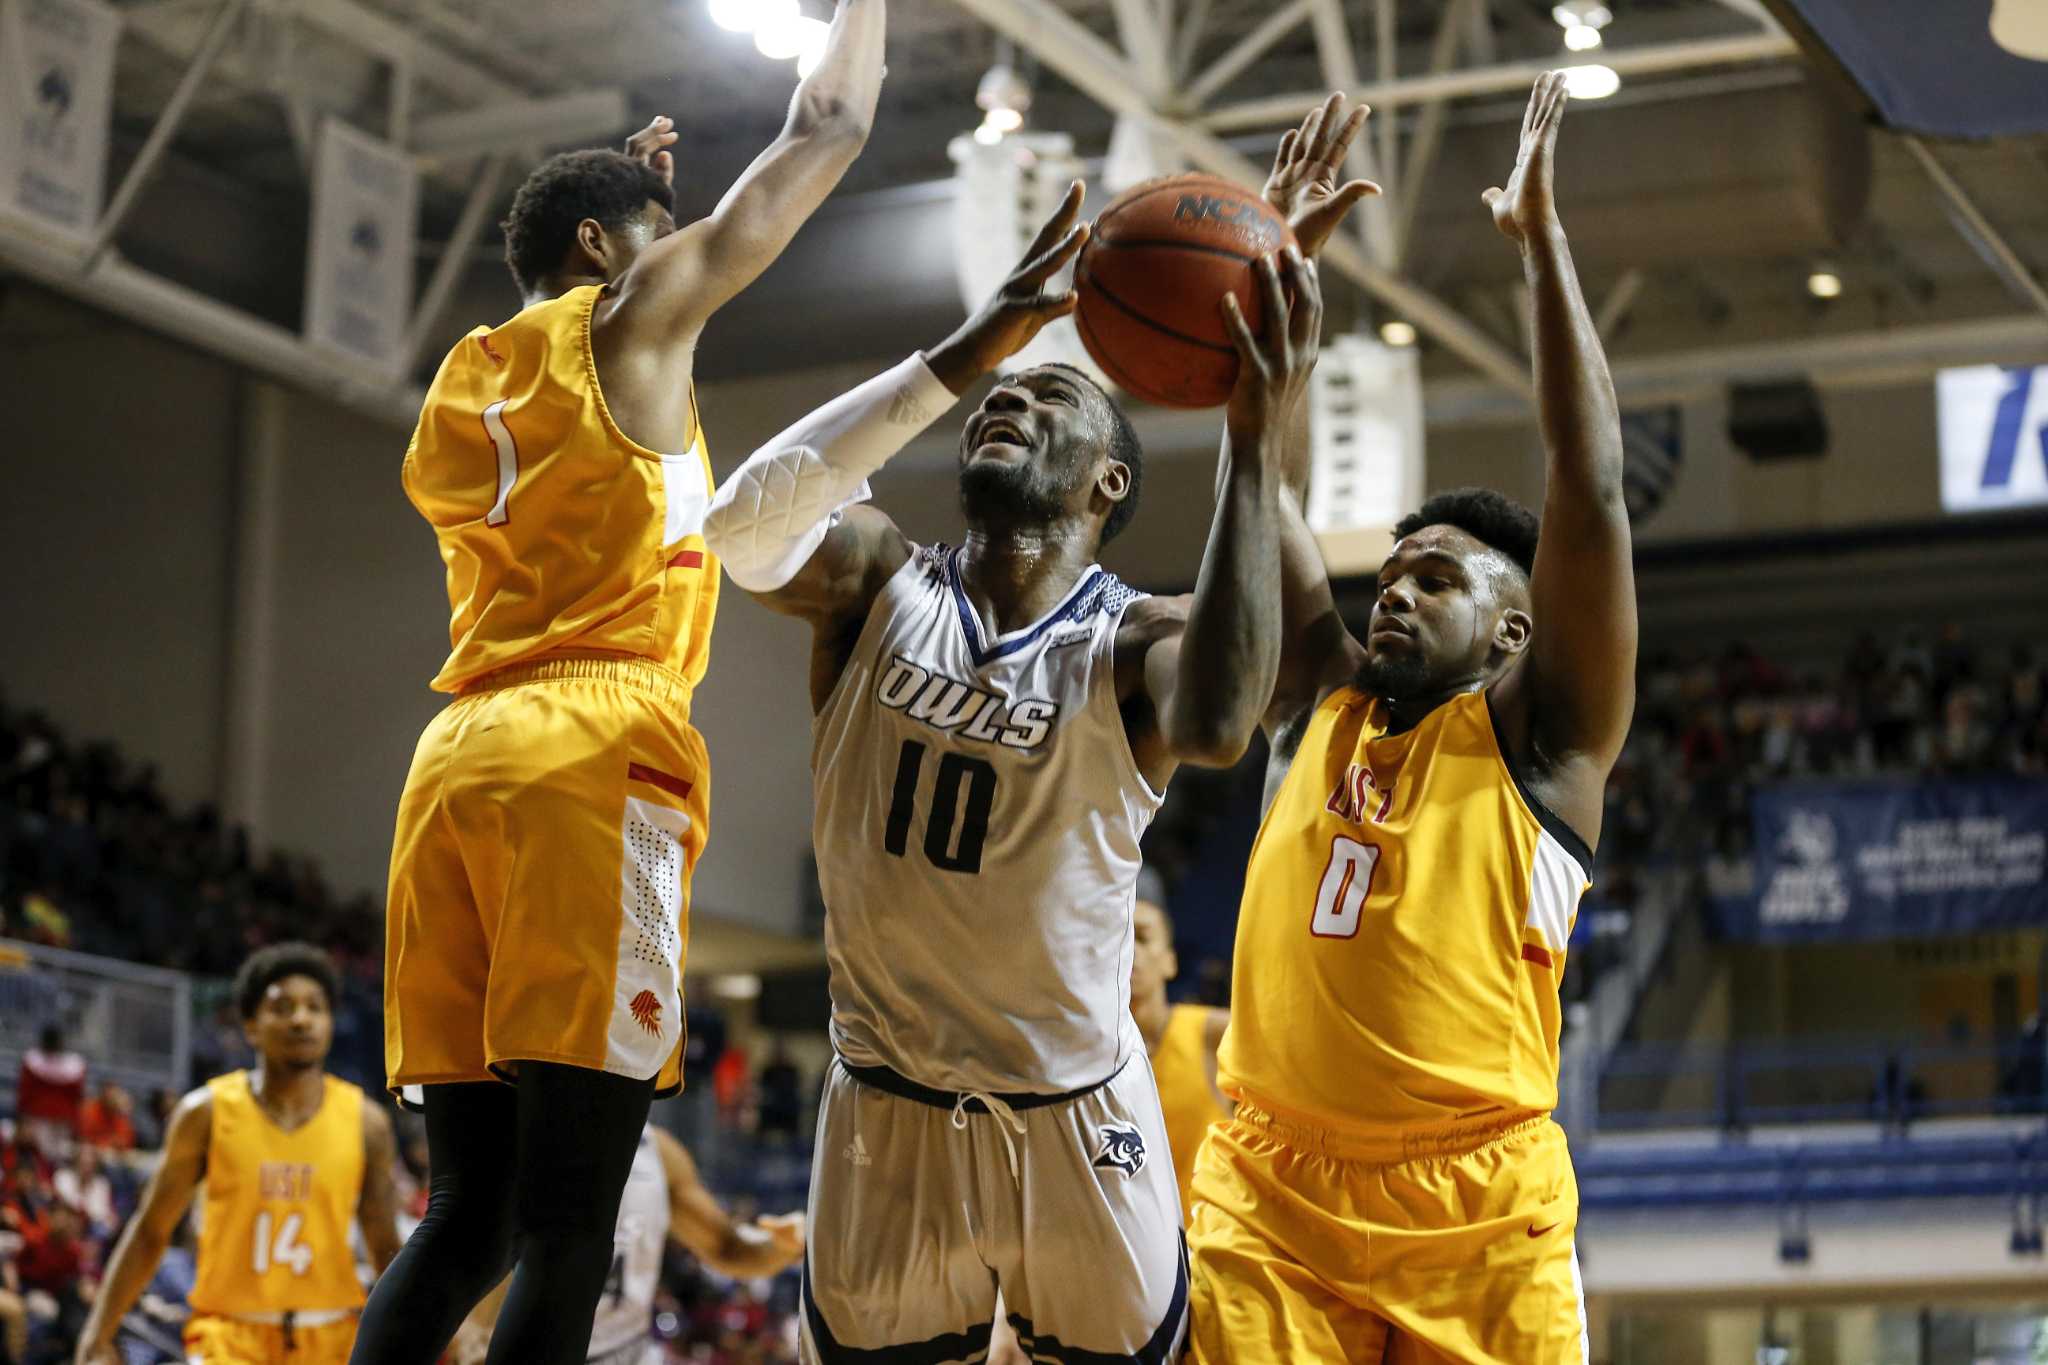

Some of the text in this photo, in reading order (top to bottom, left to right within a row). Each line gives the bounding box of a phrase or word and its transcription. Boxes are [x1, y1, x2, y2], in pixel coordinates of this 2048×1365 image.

[481, 396, 519, 528] 1
[877, 655, 1060, 749] OWLS
[884, 739, 997, 874] 10
[1310, 833, 1382, 939] 0
[253, 1211, 313, 1275] 14
